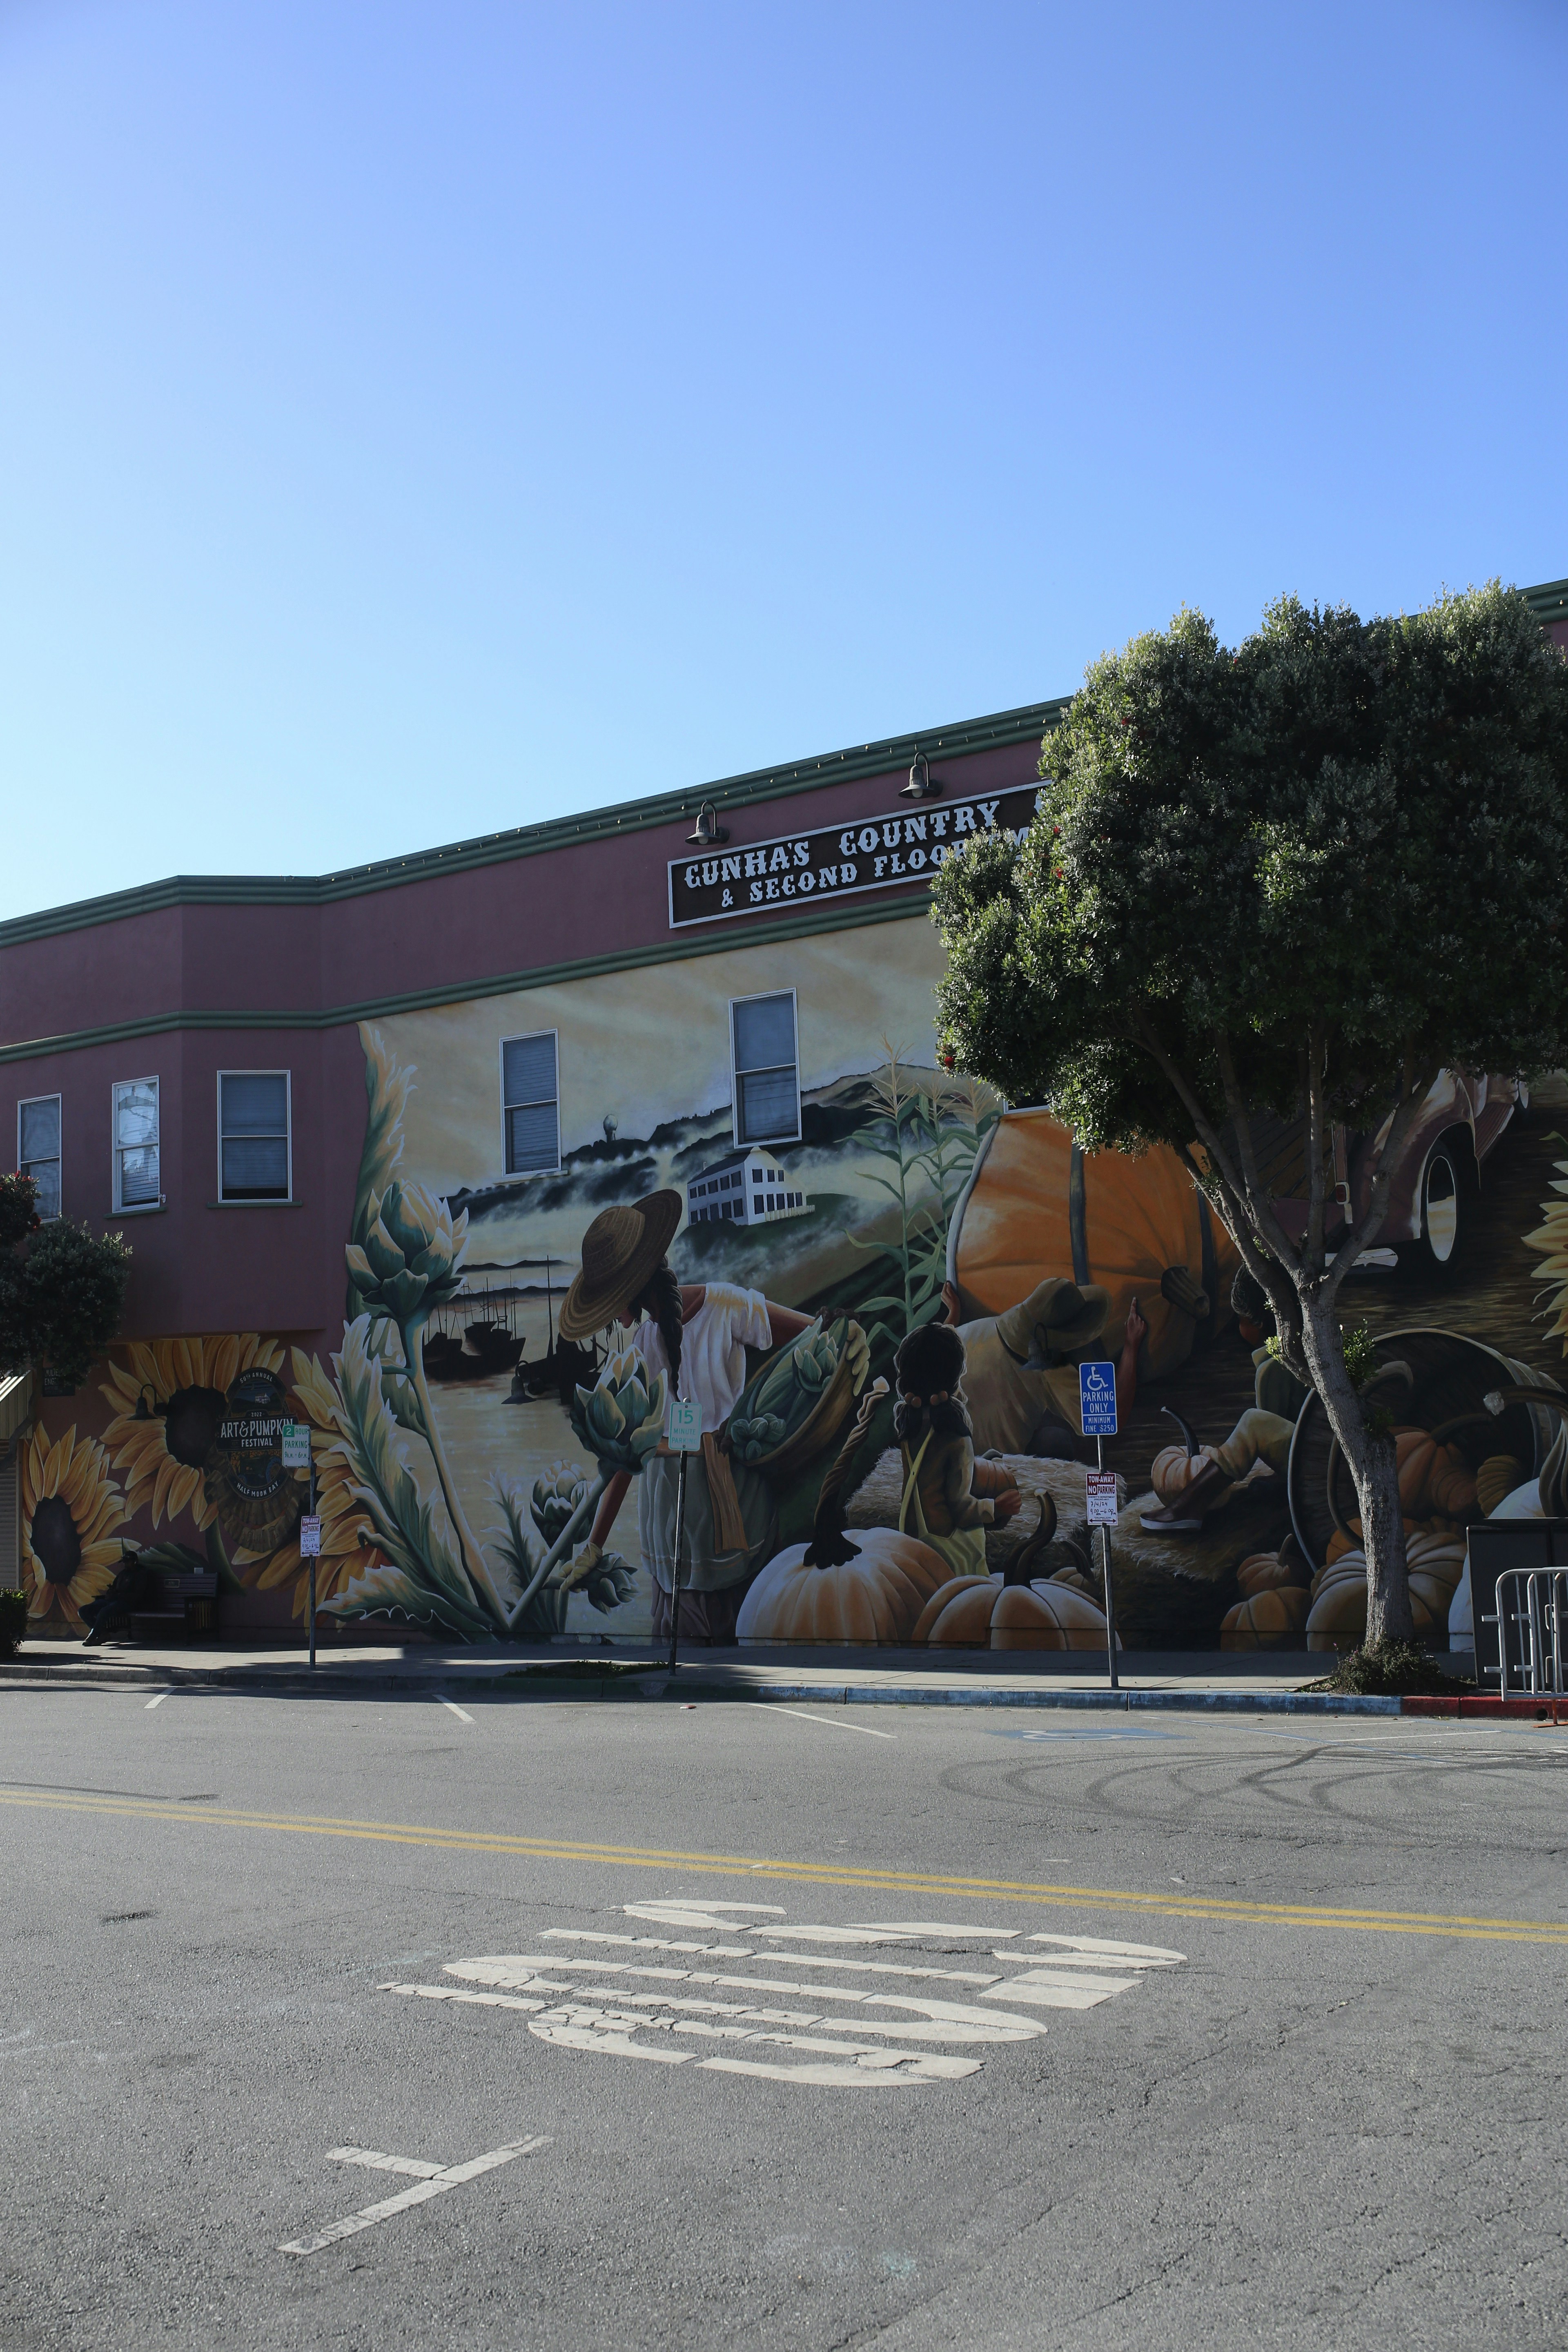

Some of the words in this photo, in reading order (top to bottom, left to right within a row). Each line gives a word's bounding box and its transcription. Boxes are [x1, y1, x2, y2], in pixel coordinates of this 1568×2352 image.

[684, 841, 809, 888] CUNHA'S
[839, 801, 999, 856] COUNTRY
[722, 889, 733, 907] &
[750, 863, 857, 902] SECOND
[252, 1372, 272, 1382] ANNUAL
[1083, 1391, 1114, 1402] PARKING
[1089, 1403, 1108, 1413] ONLY
[678, 1410, 693, 1424] 15
[220, 1422, 239, 1438] ART
[239, 1421, 249, 1437] &
[241, 1438, 273, 1447] FESTIVAL
[237, 1483, 249, 1494] HALF
[268, 1481, 278, 1493] BAY
[1088, 1486, 1097, 1494] NO
[1098, 1486, 1115, 1494] PARKING
